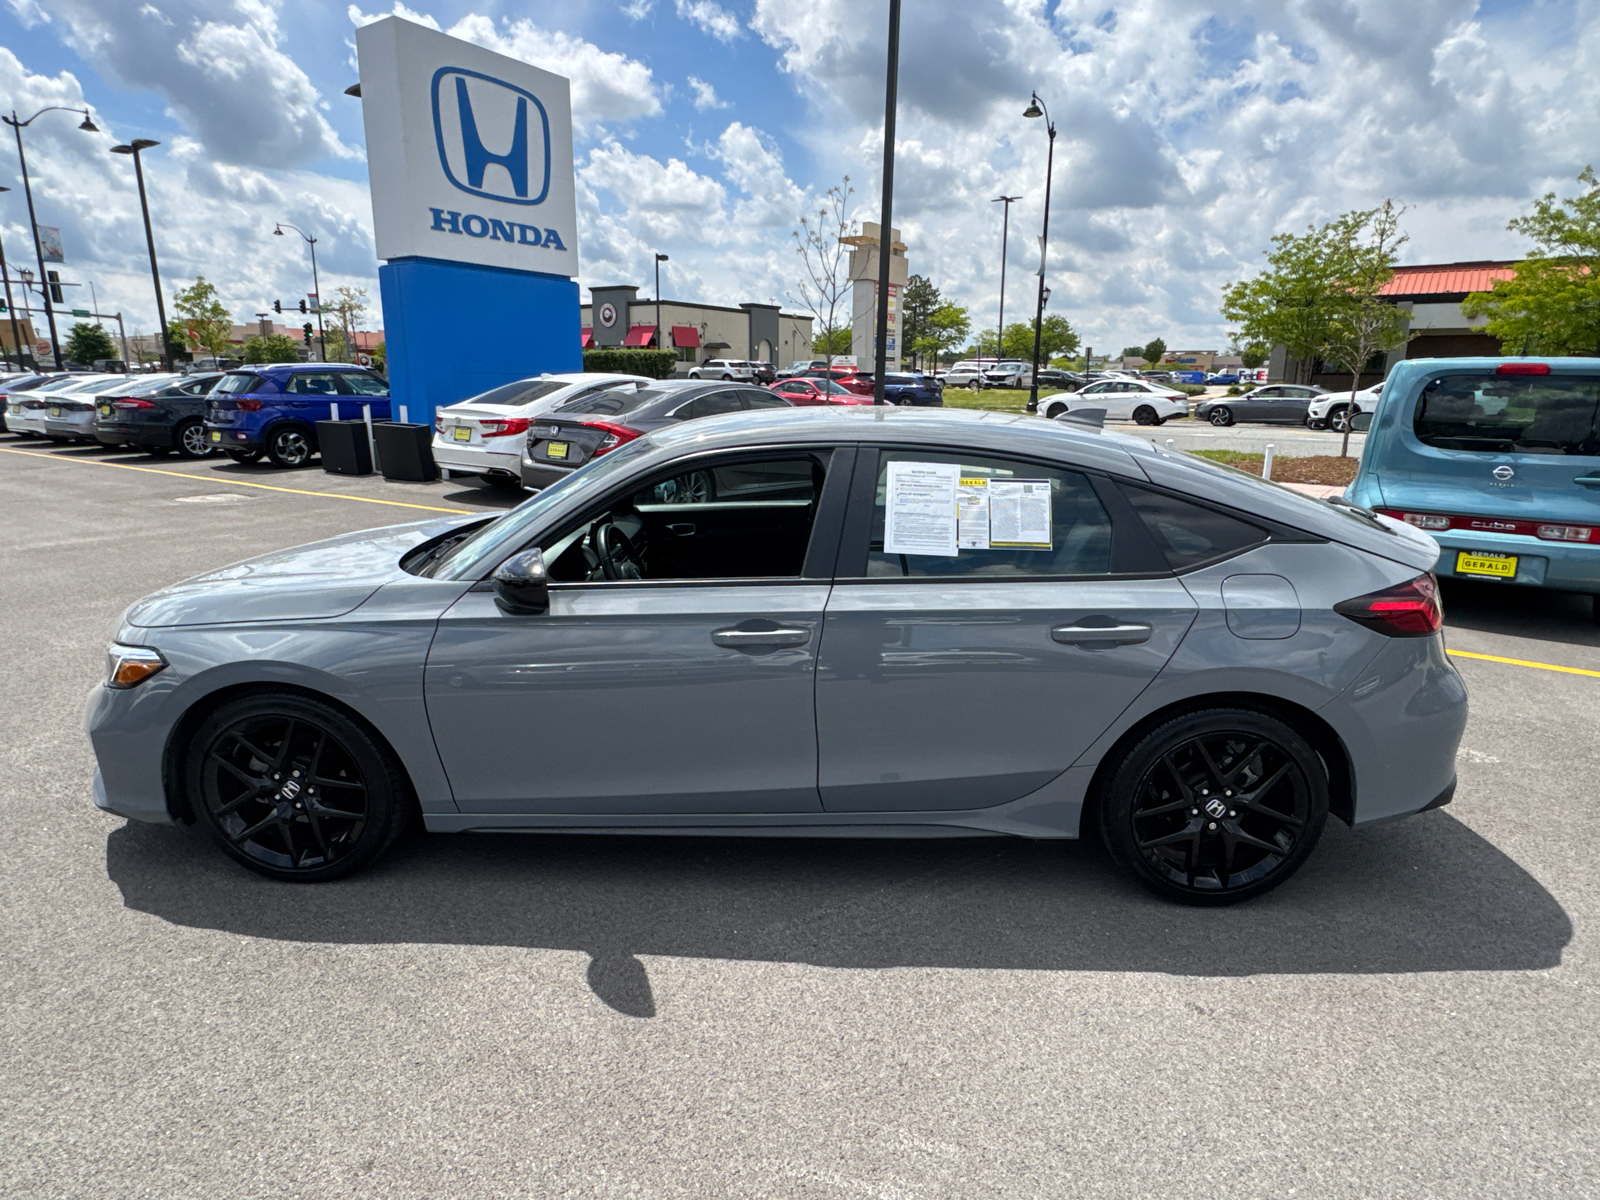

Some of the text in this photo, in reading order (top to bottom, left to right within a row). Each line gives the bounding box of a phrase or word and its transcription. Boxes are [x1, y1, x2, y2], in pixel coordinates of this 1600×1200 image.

[429, 207, 568, 251] HONDA
[1239, 370, 1268, 381] FedE
[1471, 521, 1516, 531] cube
[1471, 551, 1506, 559] GERALD
[1465, 560, 1508, 571] GERALD
